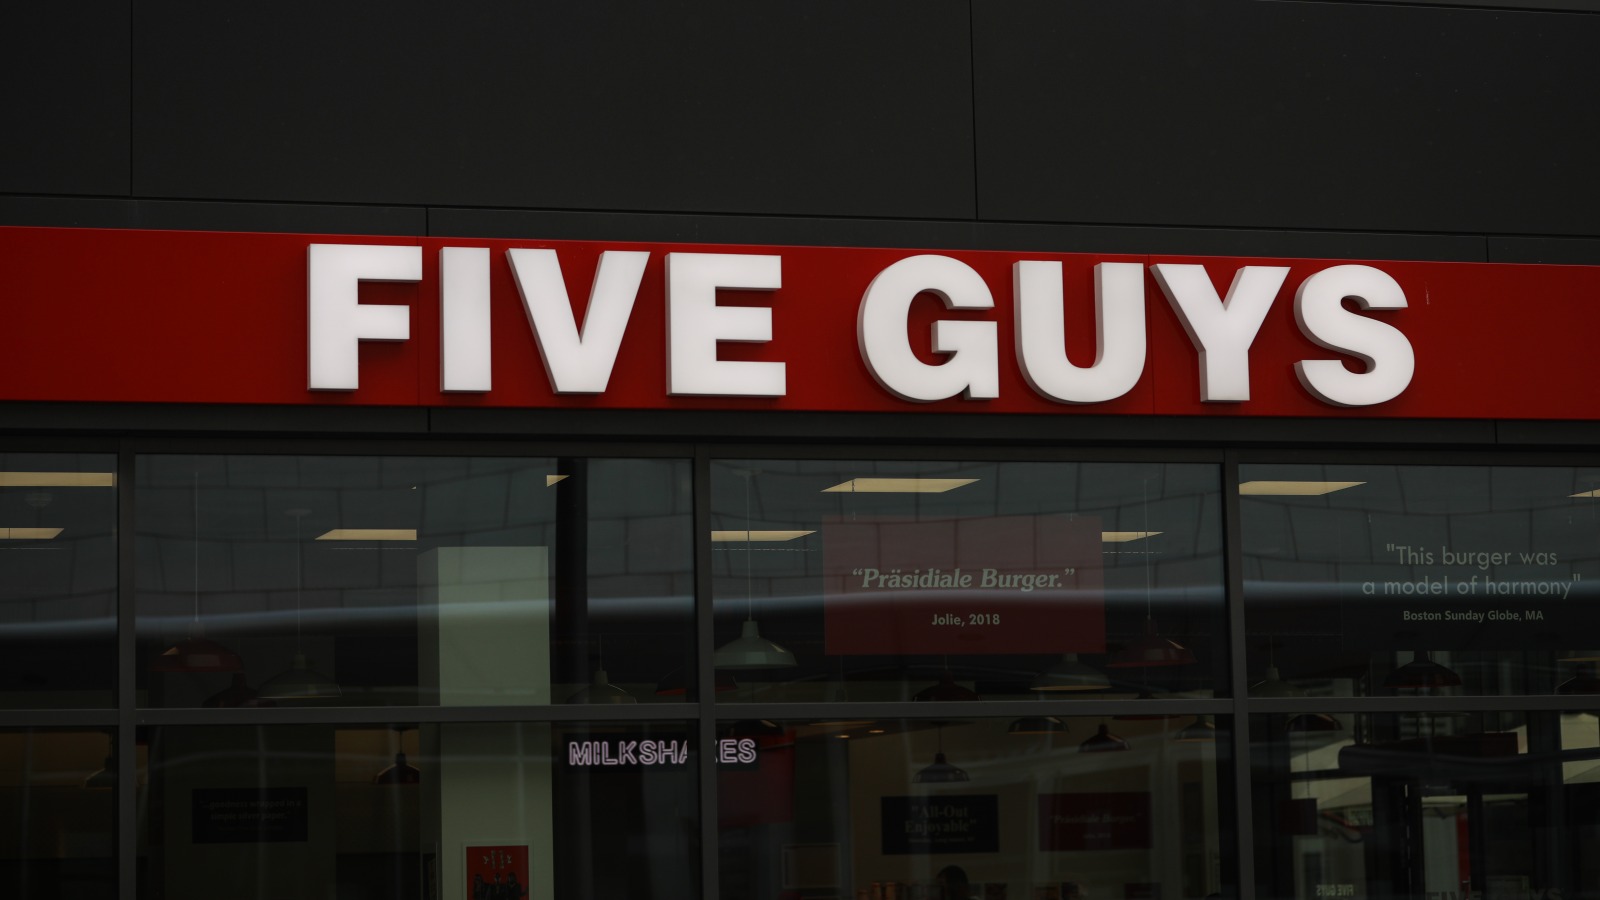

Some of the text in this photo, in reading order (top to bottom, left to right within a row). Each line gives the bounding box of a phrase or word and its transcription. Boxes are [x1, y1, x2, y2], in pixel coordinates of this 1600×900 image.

[306, 243, 1416, 407] FIVE GUYS
[1386, 543, 1558, 570] "This burger was
[852, 567, 1075, 592] “Präsidiale Burger.”
[1362, 573, 1581, 600] a model of harmony"
[931, 613, 1001, 627] Jolie, 2018
[1403, 610, 1544, 623] Boston Sunday Globe, MA
[568, 738, 757, 766] MILKSHES
